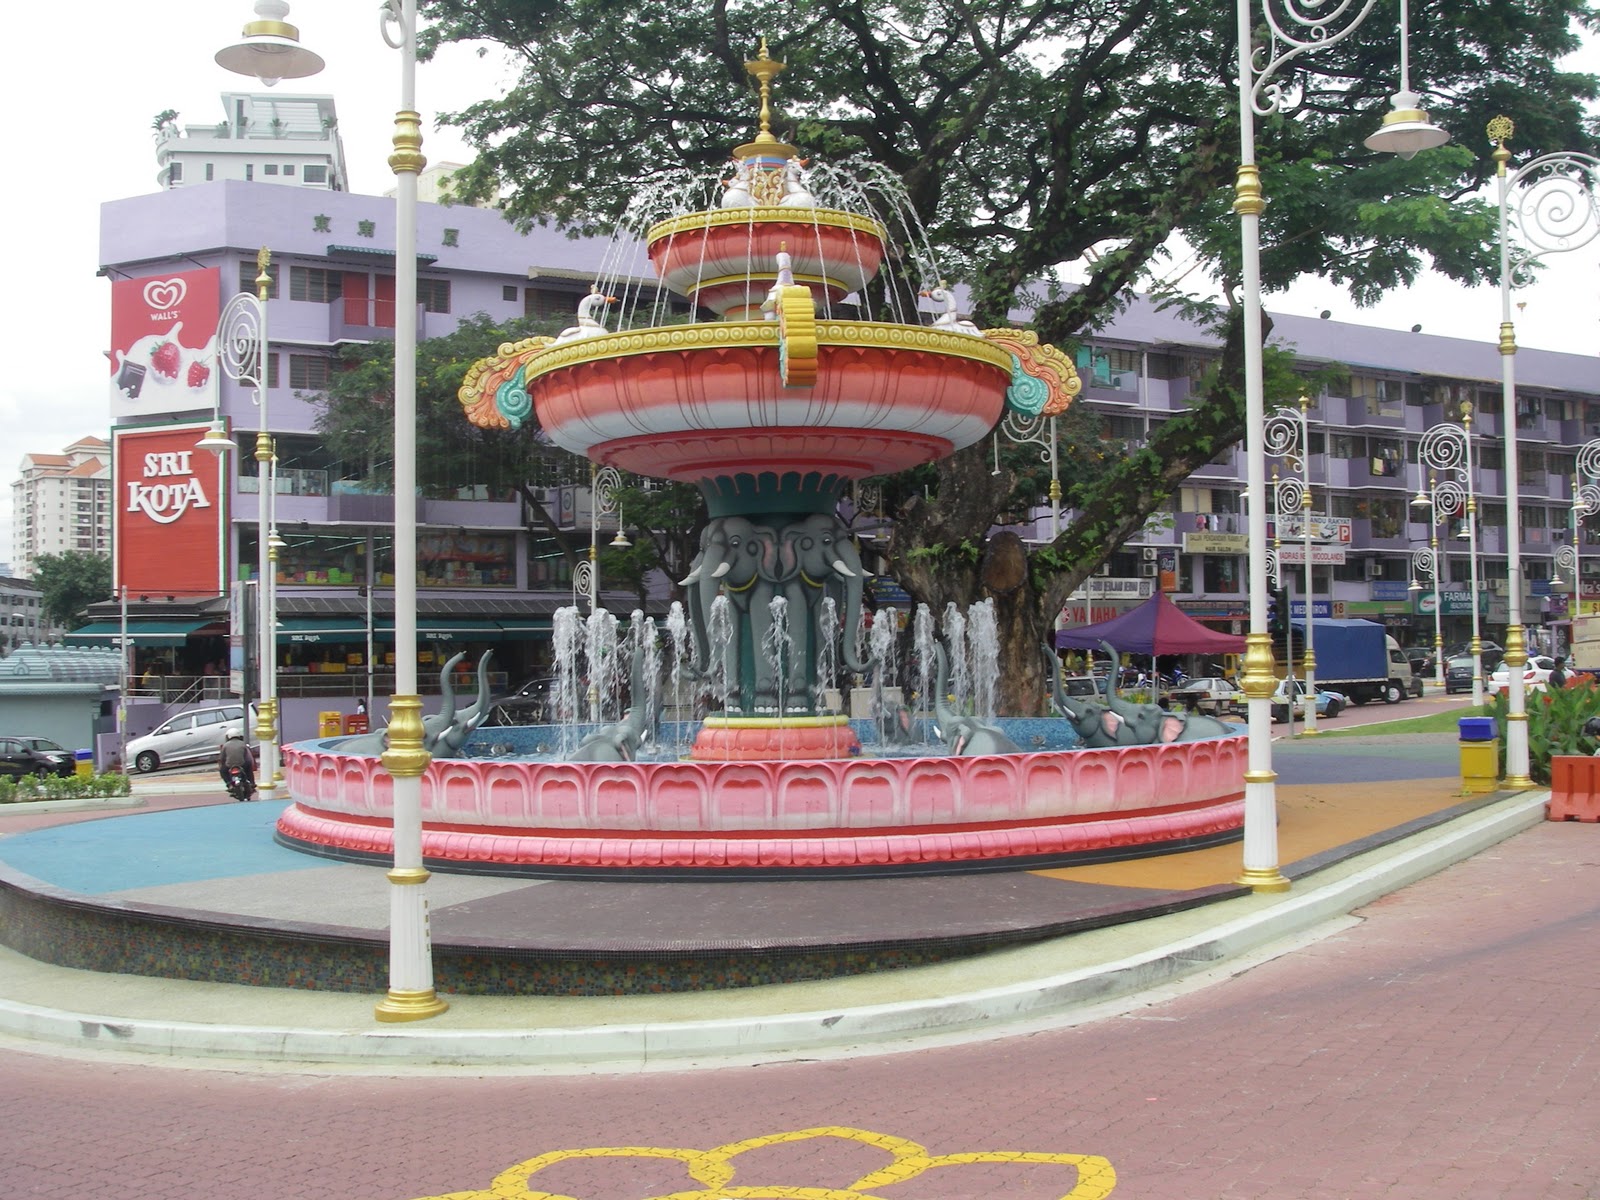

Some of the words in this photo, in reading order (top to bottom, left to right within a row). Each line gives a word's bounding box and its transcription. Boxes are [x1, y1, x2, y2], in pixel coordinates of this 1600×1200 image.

[150, 311, 179, 322] WALL'S
[143, 450, 194, 478] SRI
[127, 477, 212, 525] KOTA
[1333, 602, 1344, 615] 18
